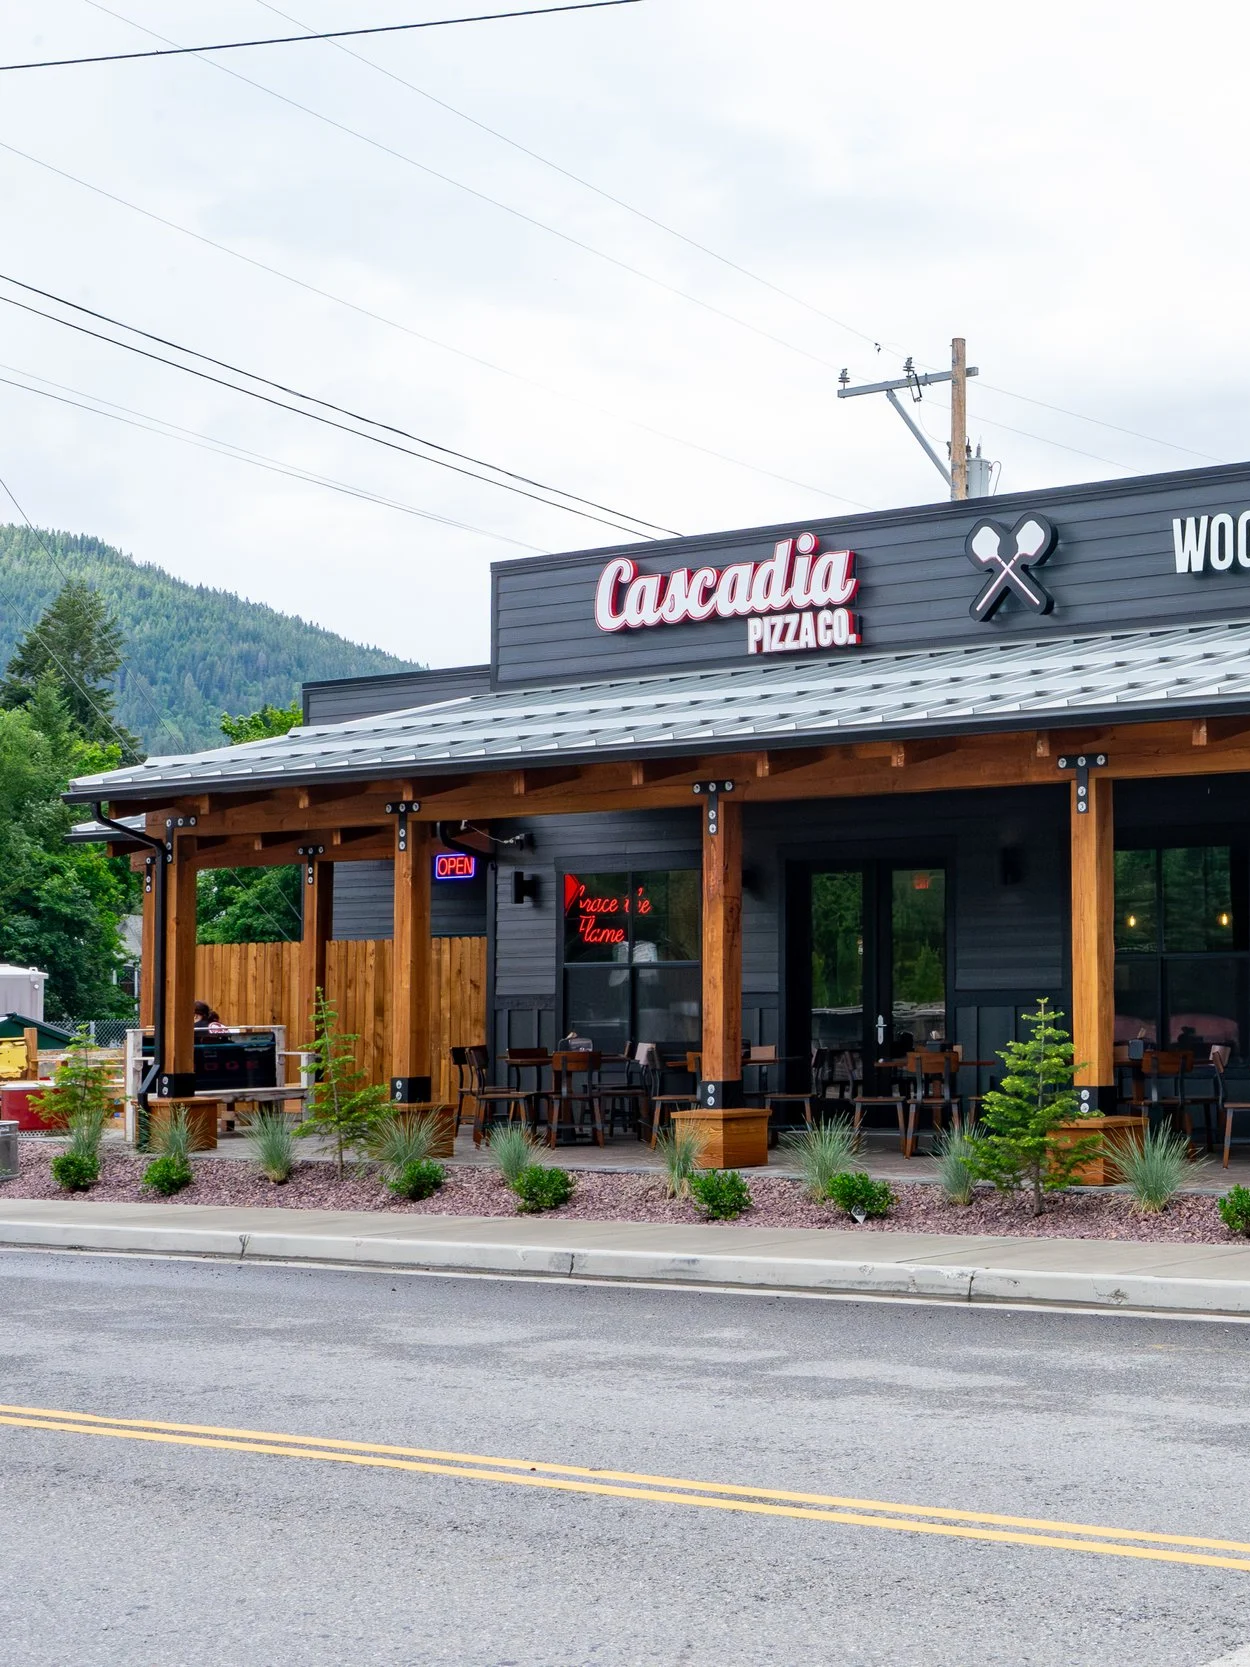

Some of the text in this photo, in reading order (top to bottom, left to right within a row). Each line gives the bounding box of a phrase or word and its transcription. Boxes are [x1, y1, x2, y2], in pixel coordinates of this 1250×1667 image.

[594, 532, 860, 631] Cascadia
[748, 611, 817, 655] PIZZA
[438, 856, 473, 875] OPEN
